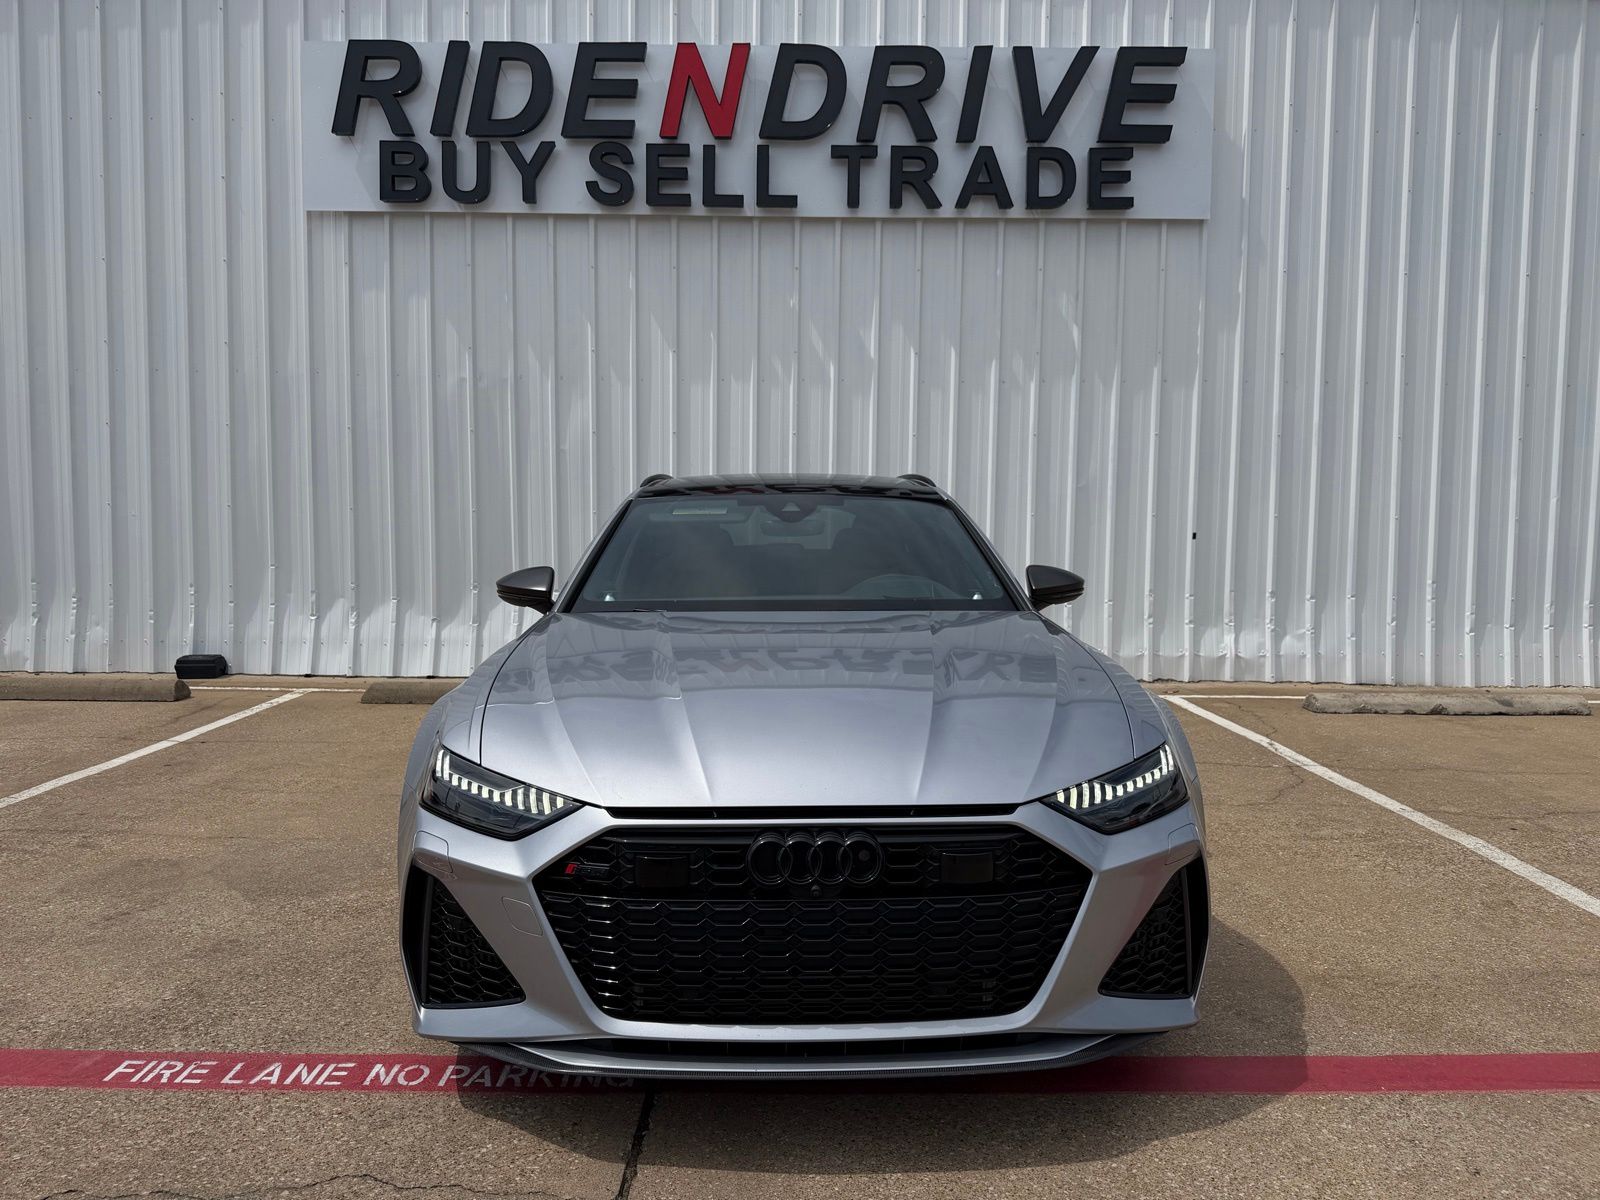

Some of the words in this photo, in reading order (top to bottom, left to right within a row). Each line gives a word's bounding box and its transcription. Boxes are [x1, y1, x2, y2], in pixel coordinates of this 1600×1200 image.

[378, 140, 556, 205] BUY
[585, 141, 798, 208] SELL
[830, 144, 1134, 210] TRADE
[102, 1060, 219, 1084] FIRE
[220, 1062, 356, 1086] LANE
[362, 1063, 430, 1087] NO
